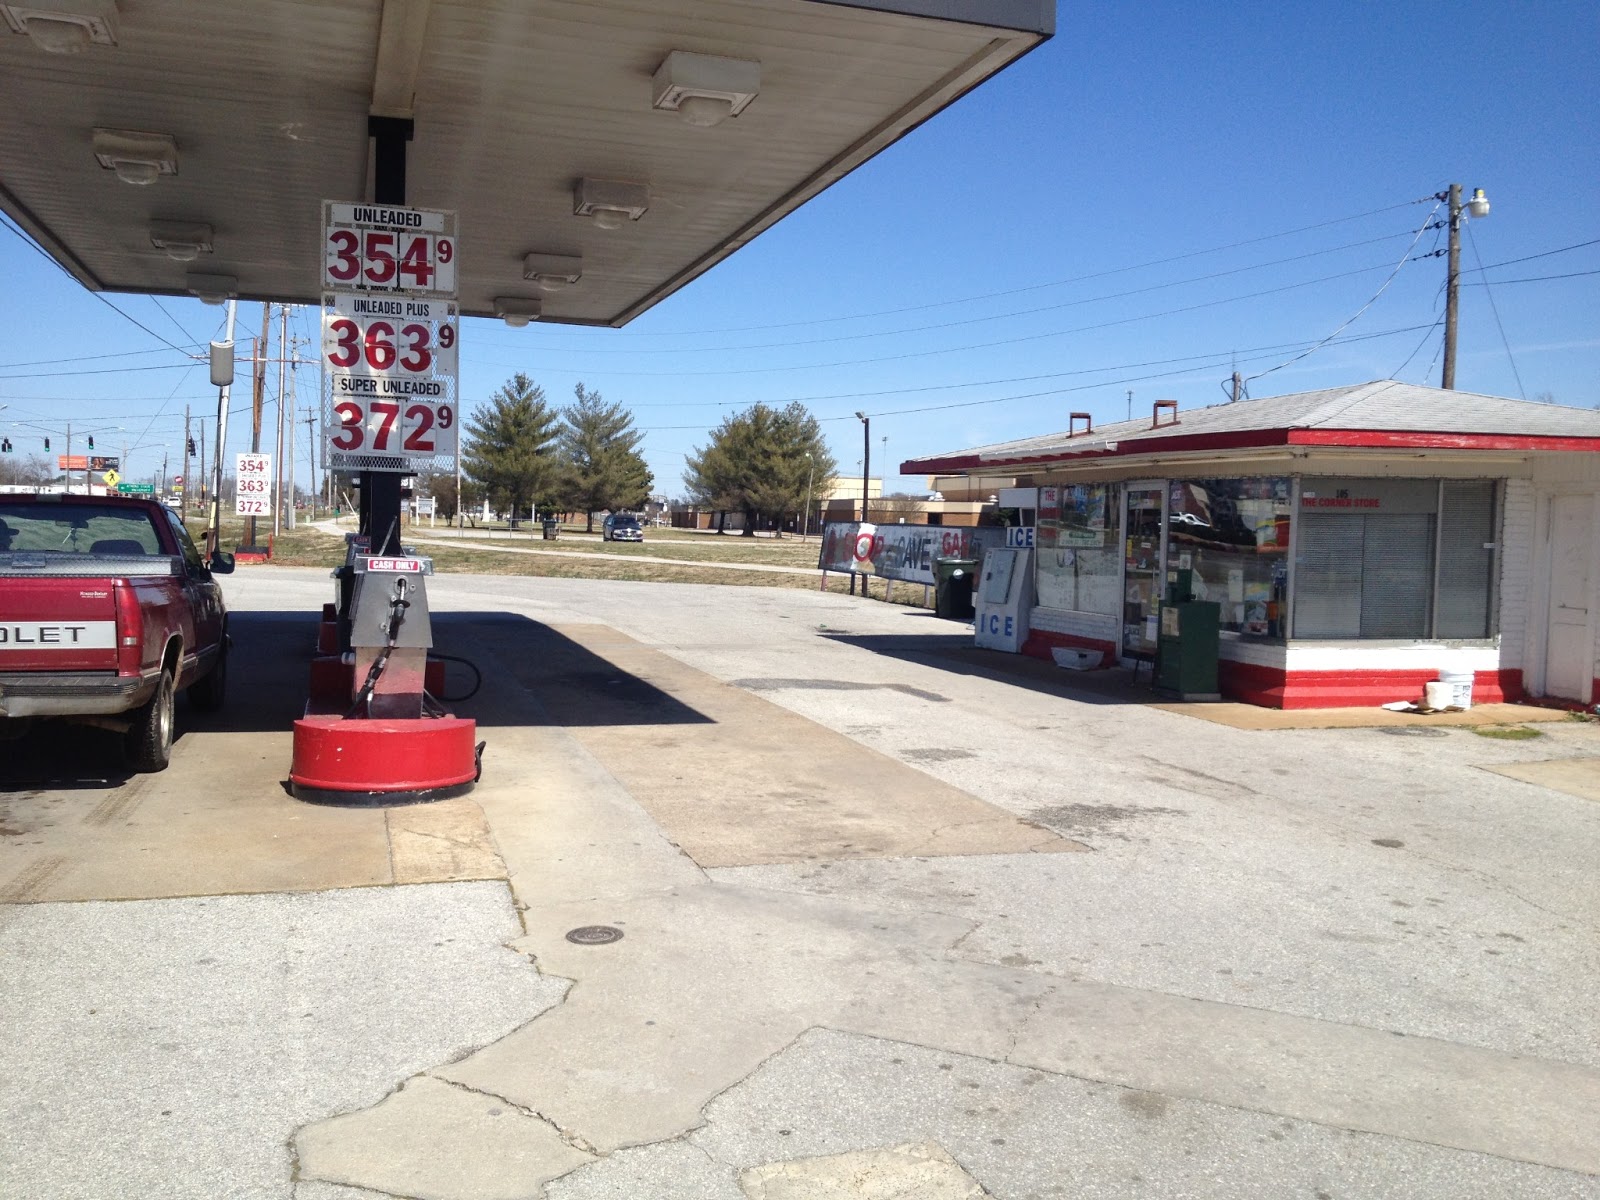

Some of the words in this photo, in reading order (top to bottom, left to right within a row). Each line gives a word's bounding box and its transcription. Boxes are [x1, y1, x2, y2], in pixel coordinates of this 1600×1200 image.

[353, 207, 422, 227] UNLEADED
[353, 299, 402, 315] UNLEADED
[406, 302, 430, 317] PLUS
[341, 378, 377, 393] SUPER
[383, 380, 441, 395] UNLEADED
[1045, 490, 1056, 501] THE
[1302, 498, 1317, 507] THE
[1319, 498, 1352, 507] CORNER
[1354, 498, 1380, 507] STORE
[1009, 527, 1033, 547] ICE
[373, 560, 394, 569] CASH
[396, 561, 415, 570] ONLY
[981, 613, 1013, 636] ICE
